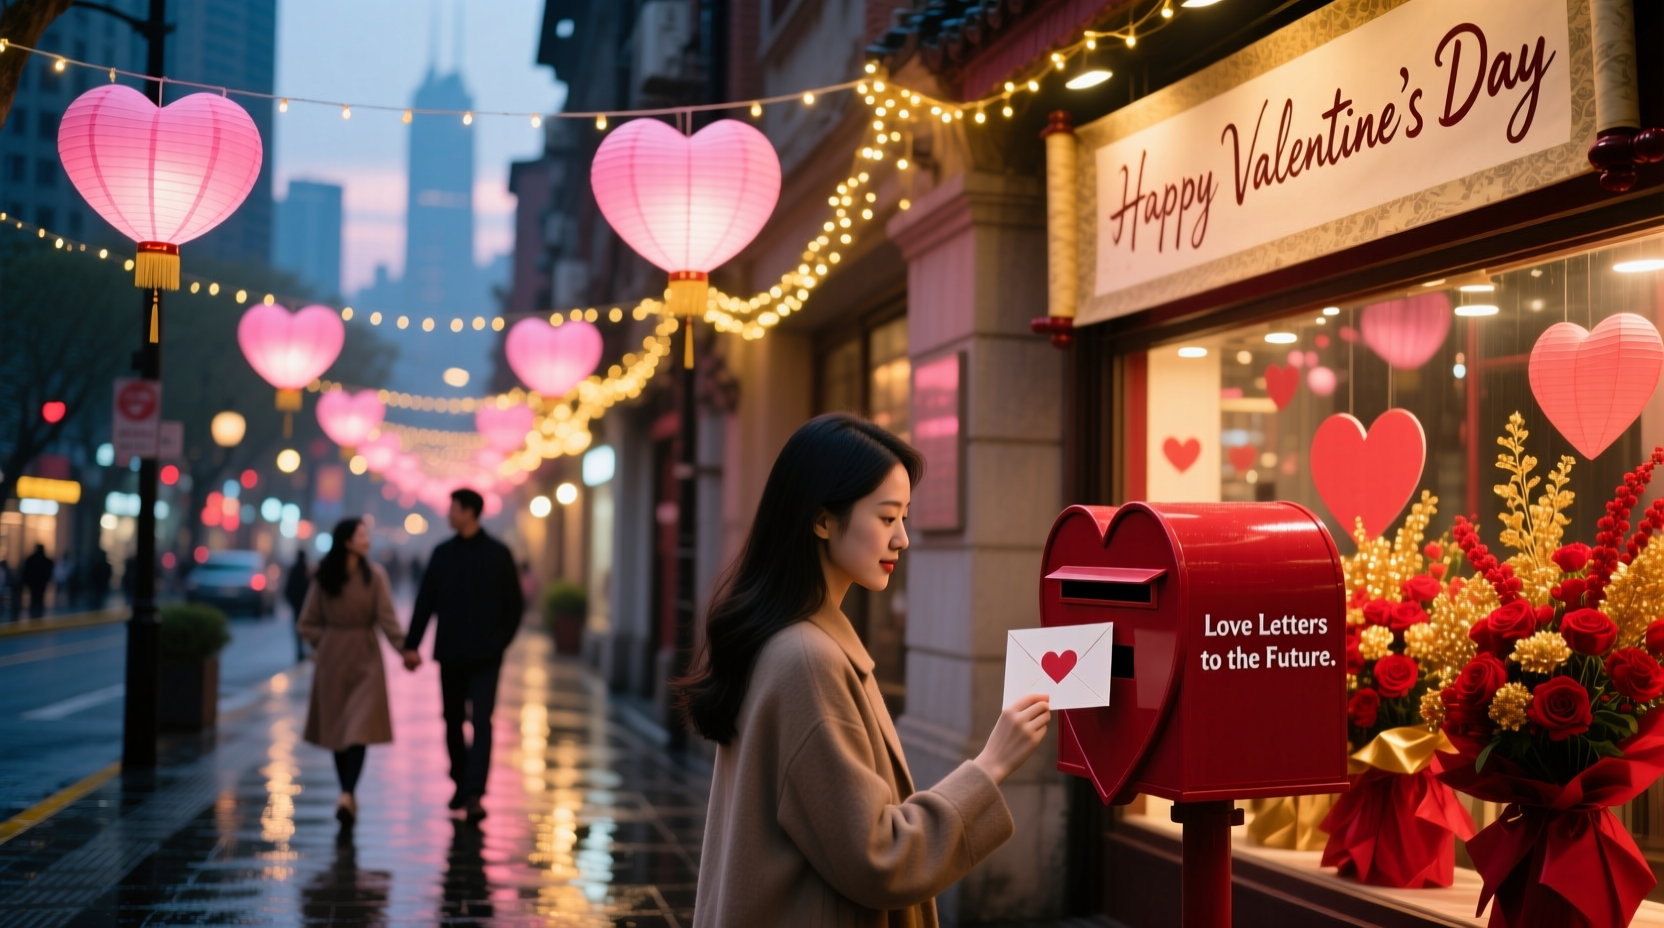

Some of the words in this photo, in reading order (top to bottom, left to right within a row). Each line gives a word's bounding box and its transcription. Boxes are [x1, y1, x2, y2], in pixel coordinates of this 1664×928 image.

[1110, 150, 1218, 253] Happy
[1221, 67, 1424, 206] Valentine's
[1434, 22, 1556, 144] Day
[1204, 613, 1253, 637] Love
[1258, 612, 1328, 636] Letters
[1200, 650, 1222, 671] to
[1227, 645, 1260, 670] the
[1266, 645, 1337, 669] Future.
